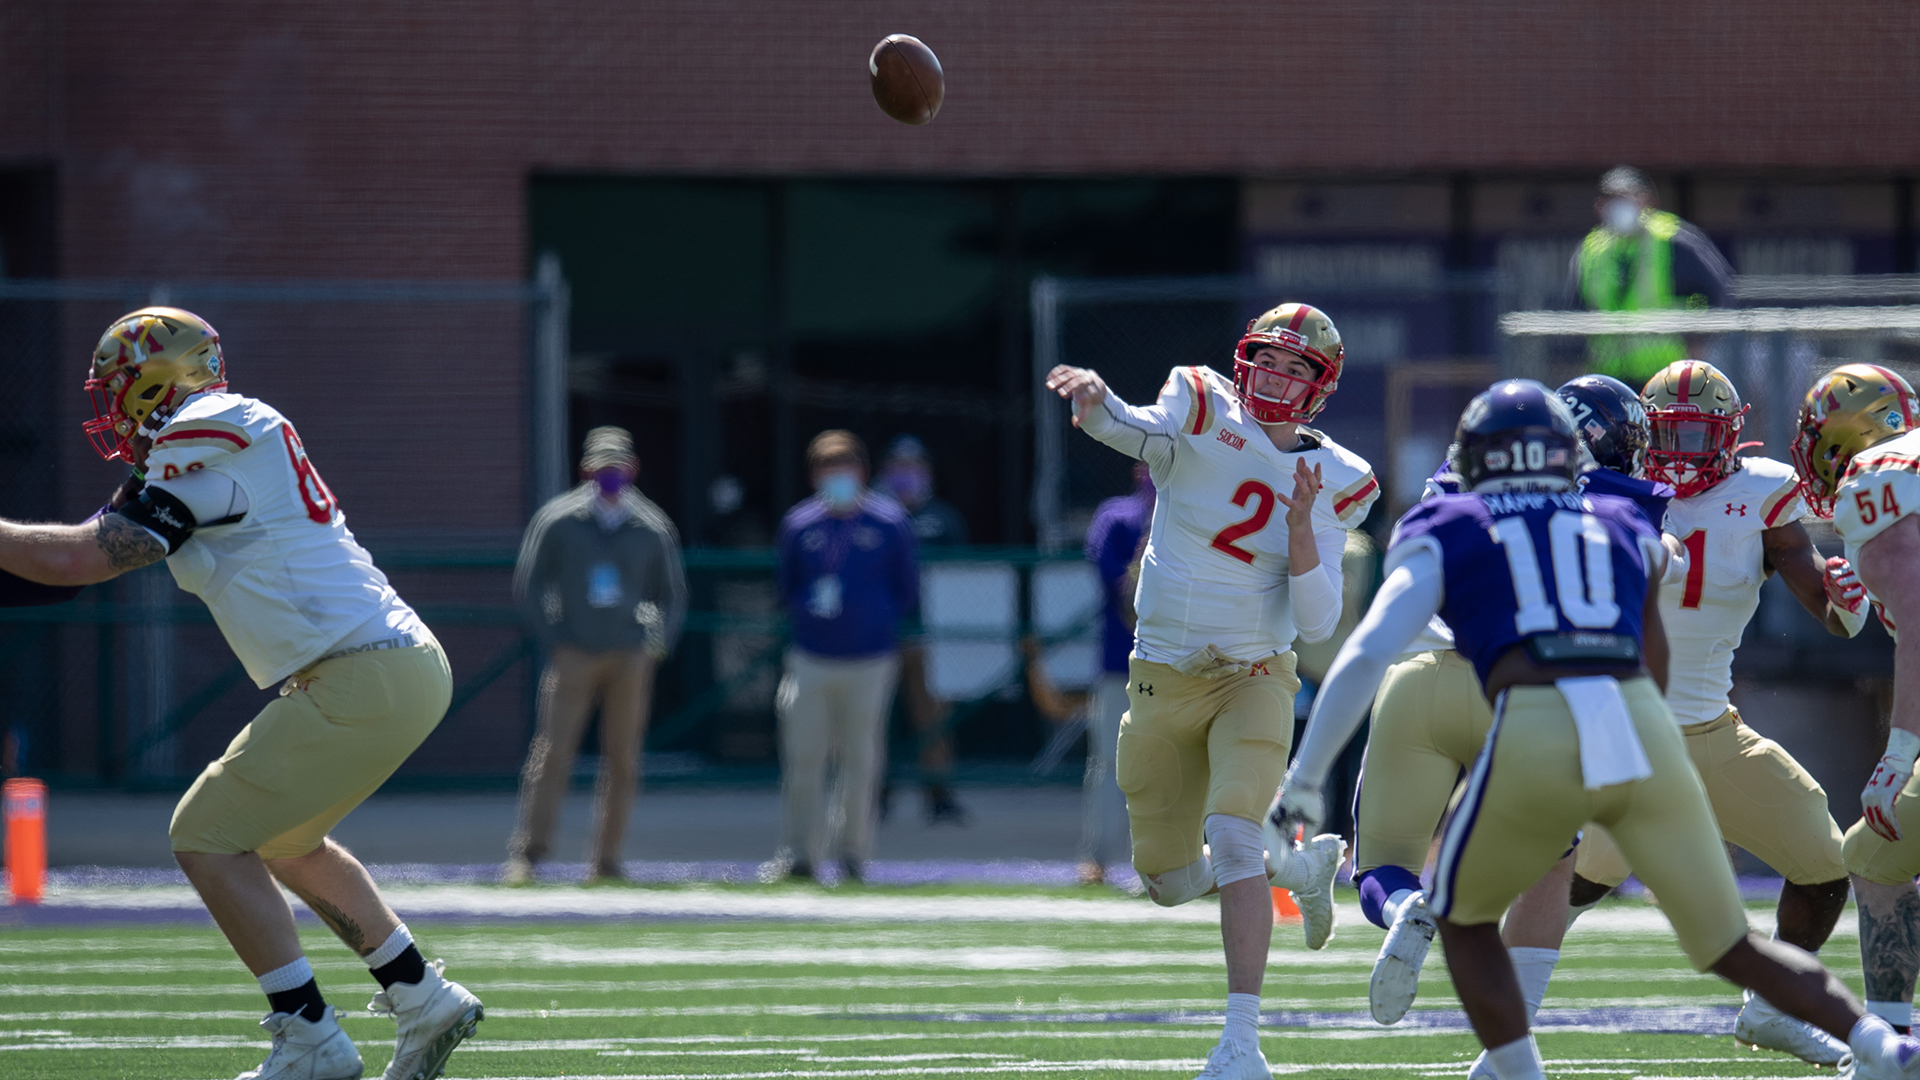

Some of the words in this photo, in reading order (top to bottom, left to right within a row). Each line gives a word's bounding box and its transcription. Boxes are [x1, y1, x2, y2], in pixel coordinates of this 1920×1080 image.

[282, 421, 338, 525] 6
[1216, 427, 1247, 451] SOCON
[1511, 440, 1547, 472] 10
[1208, 477, 1277, 566] 2
[1853, 481, 1902, 526] 54
[1488, 509, 1622, 636] 10
[1679, 527, 1708, 611] 1
